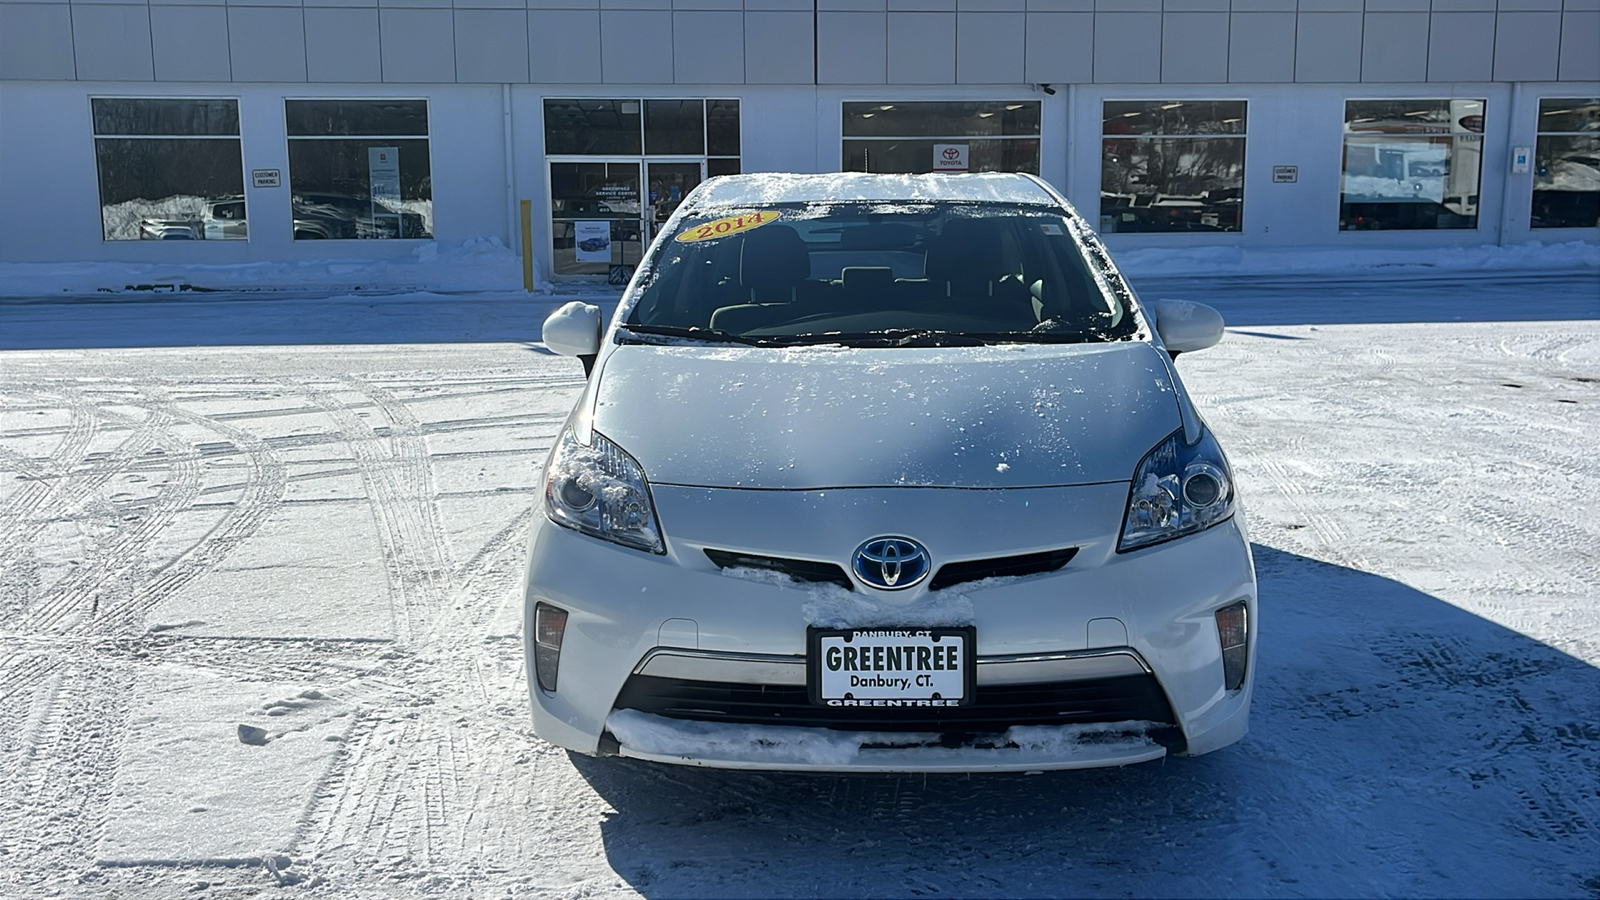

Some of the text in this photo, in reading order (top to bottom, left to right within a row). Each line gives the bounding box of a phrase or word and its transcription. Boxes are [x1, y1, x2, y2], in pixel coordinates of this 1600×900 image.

[696, 212, 764, 239] 2014
[915, 630, 932, 638] CT
[826, 646, 958, 671] GREENTREE
[850, 674, 934, 691] Danbury, CT.
[826, 699, 960, 707] GREENTREE
